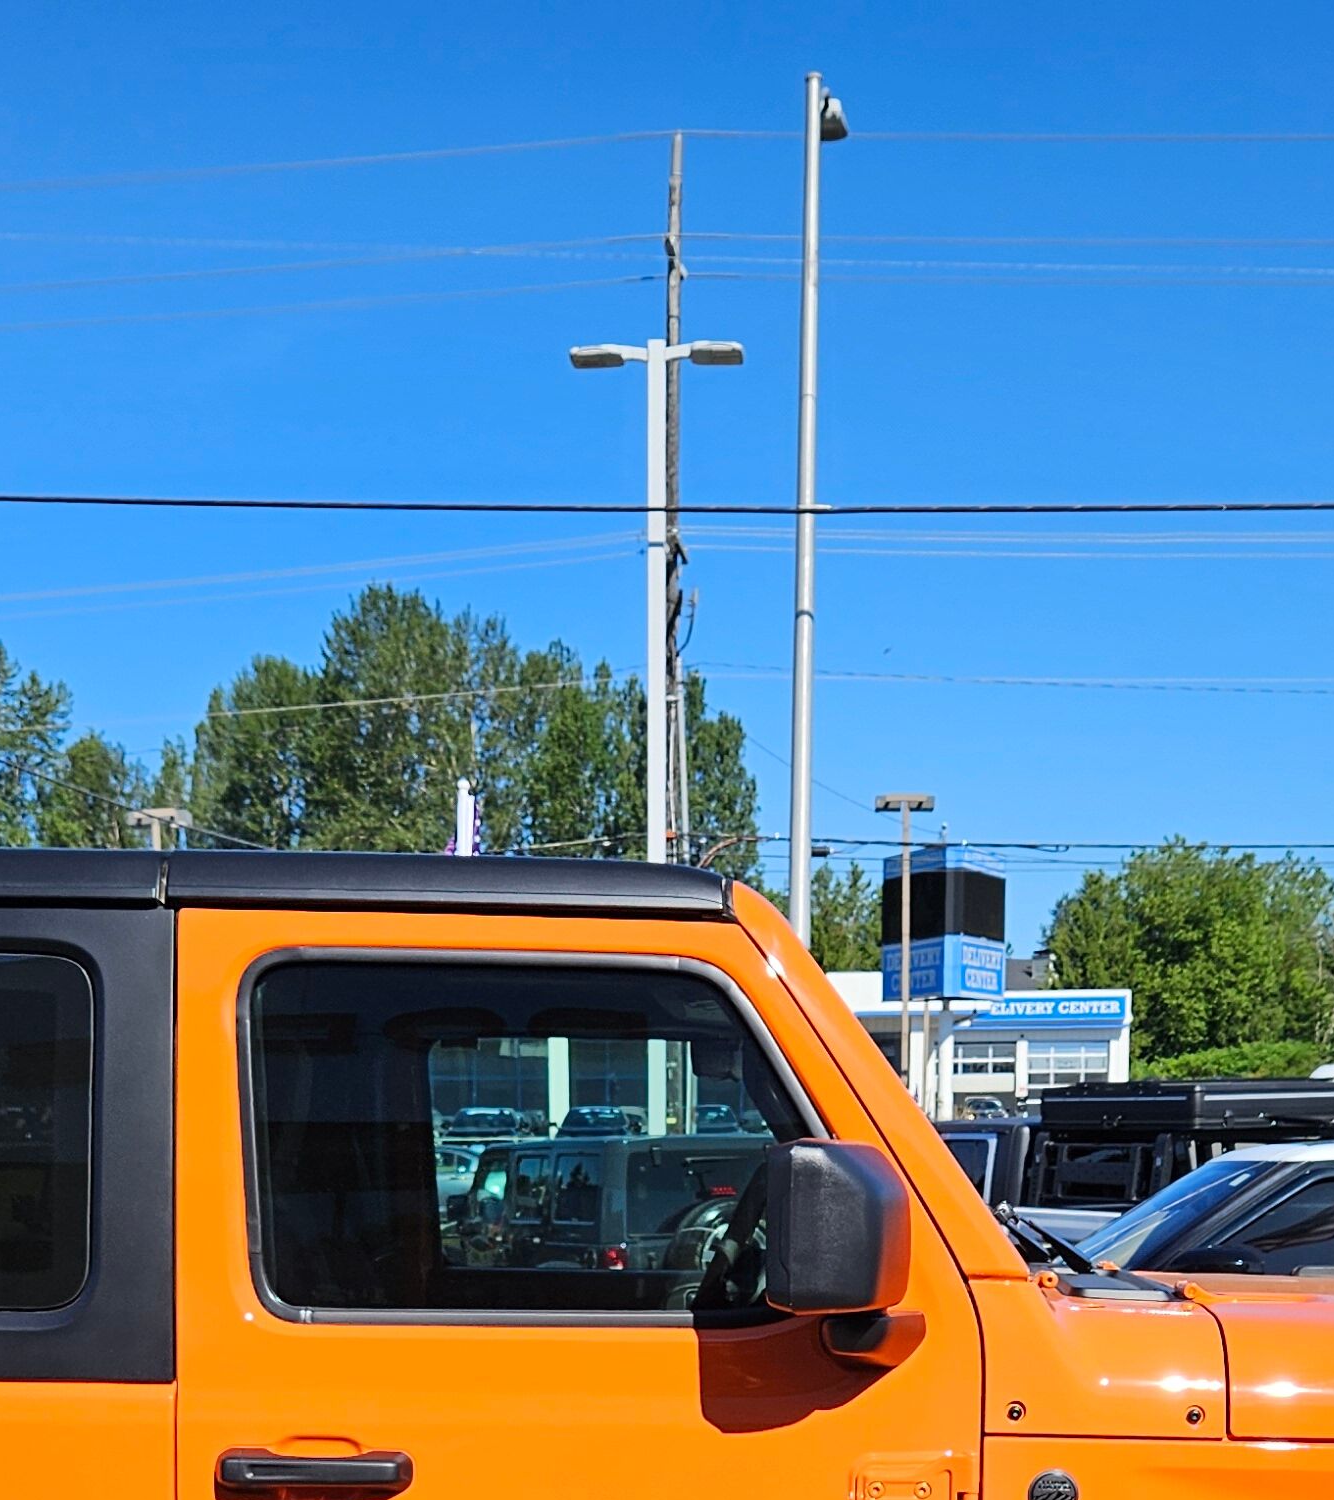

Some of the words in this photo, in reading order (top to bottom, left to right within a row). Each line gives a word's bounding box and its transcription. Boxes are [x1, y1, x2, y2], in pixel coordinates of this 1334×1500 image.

[886, 946, 942, 972] DEVERY
[989, 1001, 1055, 1015] ELIVERY
[1057, 1000, 1121, 1014] CENTER
